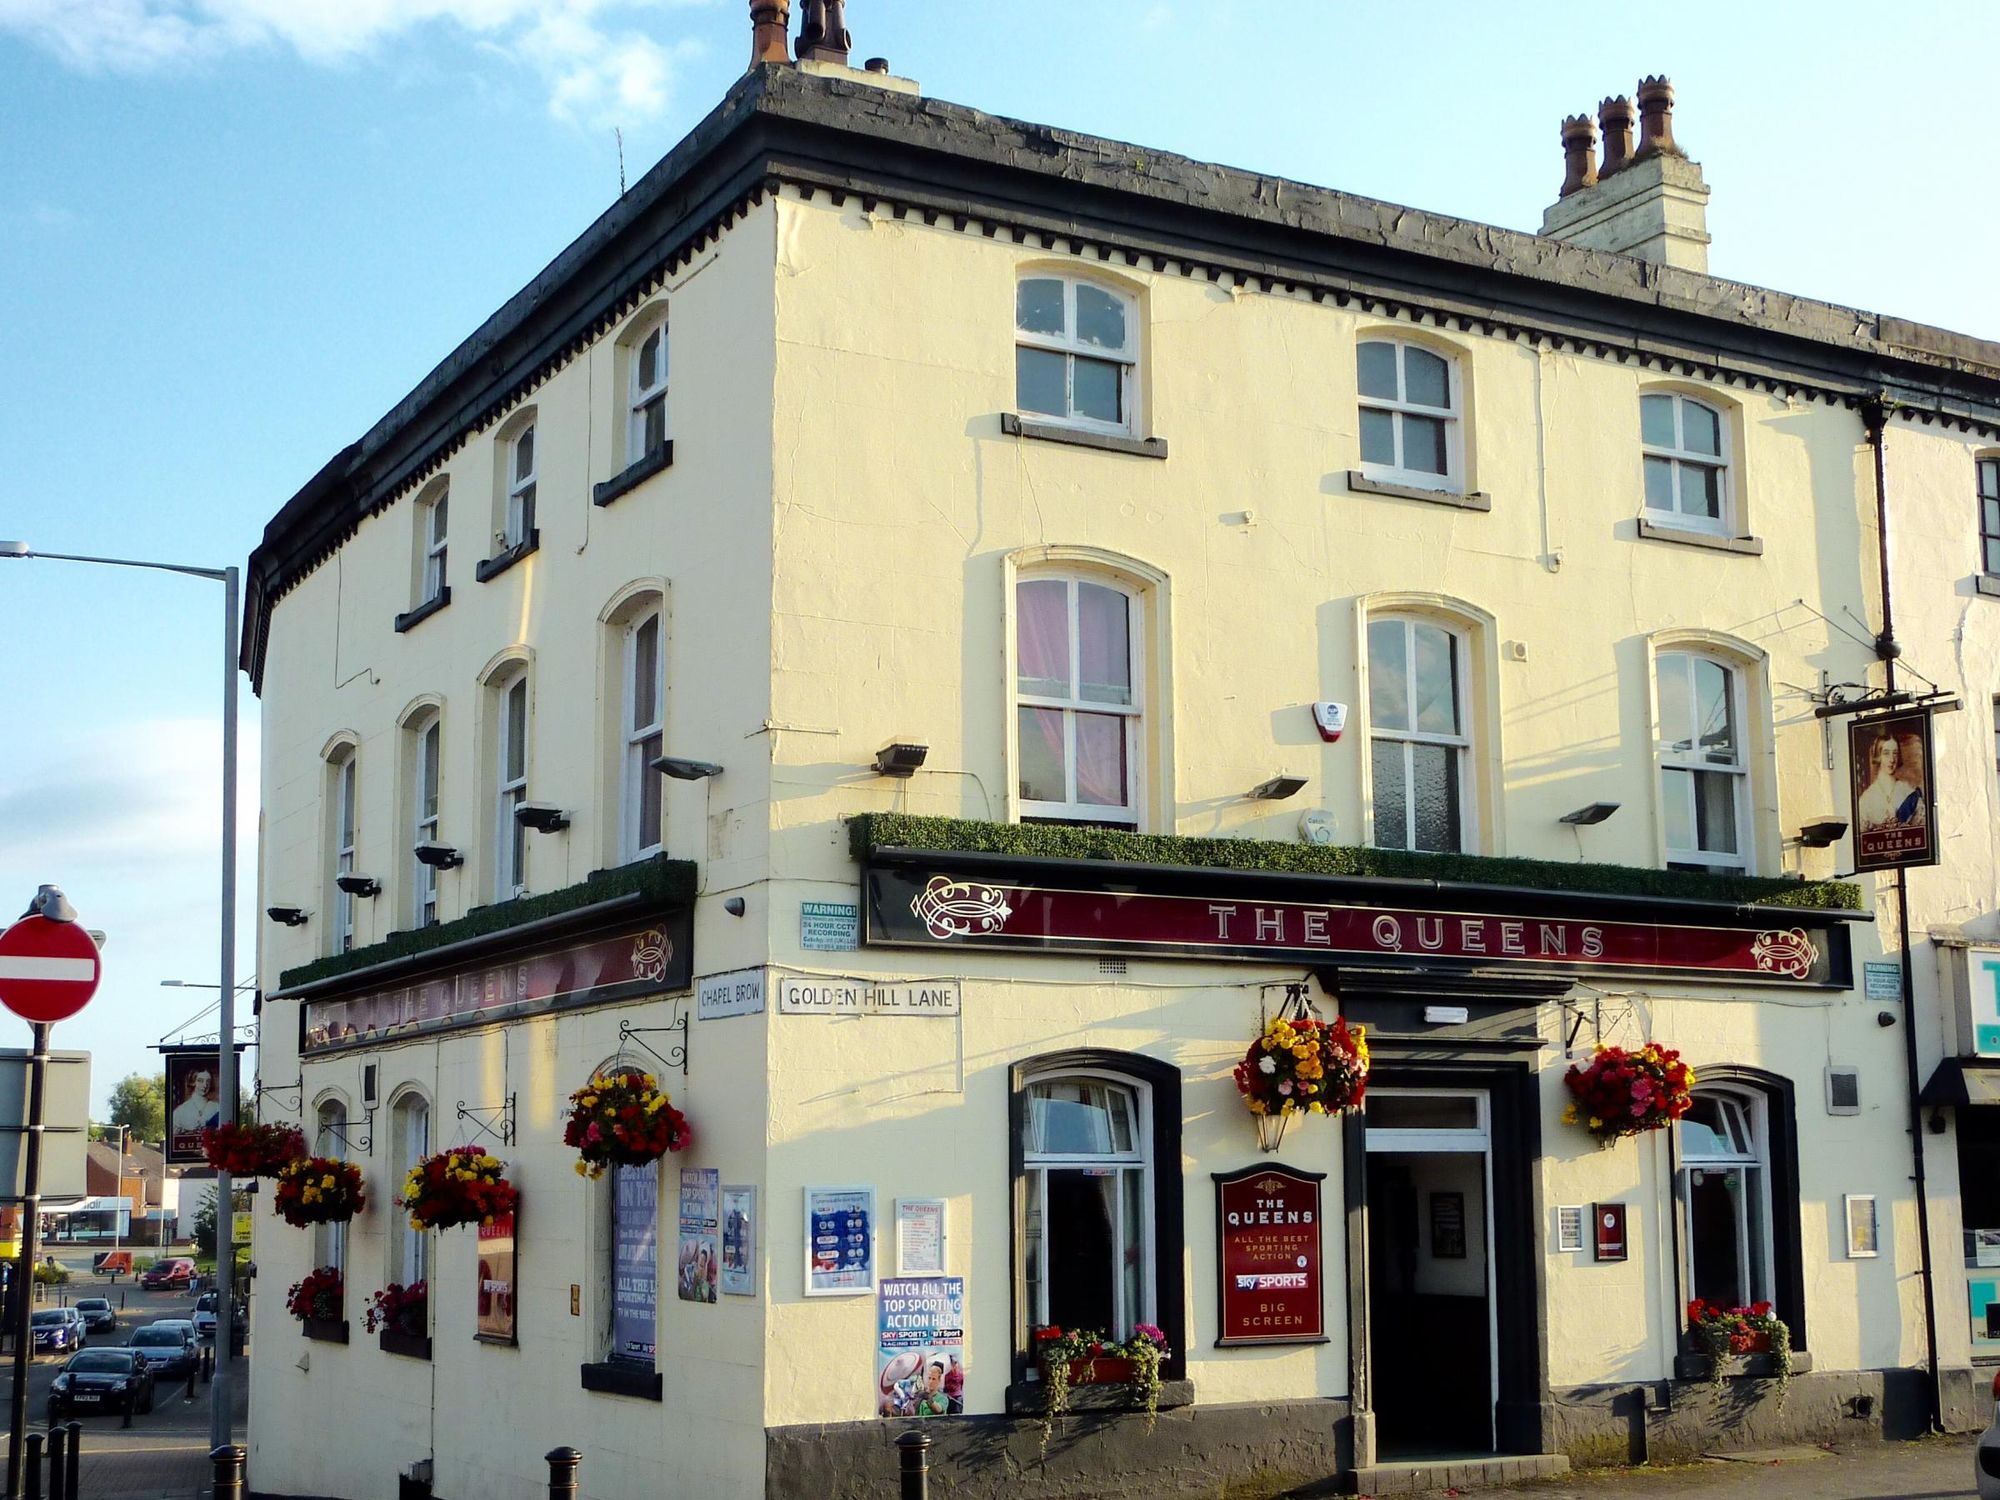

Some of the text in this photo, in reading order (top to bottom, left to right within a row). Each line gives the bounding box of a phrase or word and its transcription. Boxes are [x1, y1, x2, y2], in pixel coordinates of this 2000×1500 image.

[1885, 832, 1903, 840] THE
[1867, 838, 1922, 852] QUEENS
[803, 903, 856, 917] WARNING!
[813, 922, 835, 930] HOUR
[836, 923, 856, 931] CCTV
[1208, 904, 1331, 946] THE
[807, 928, 851, 938] RECORDING
[1372, 914, 1604, 959] QUEENS
[439, 965, 528, 1012] QUEENS
[701, 983, 761, 1007] CHAPEL BROW
[789, 986, 953, 1008] GOLDEN HILL LANE
[1257, 1199, 1285, 1209] THE
[1228, 1210, 1313, 1226] QUEENS
[1259, 1235, 1278, 1243] THE
[1283, 1235, 1310, 1243] BEST
[1245, 1244, 1299, 1252] SPORTING
[632, 1278, 649, 1293] THE
[883, 1282, 961, 1296] WATCH ALL THE
[1237, 1275, 1307, 1290] sky SPORTS
[883, 1298, 961, 1312] TOP SPORTING
[1260, 1303, 1286, 1312] BIG
[886, 1313, 958, 1328] ACTION HERE
[1242, 1315, 1303, 1326] SCREEN
[882, 1331, 897, 1339] SKY
[898, 1330, 927, 1338] SPORTS
[943, 1329, 960, 1338] Sport
